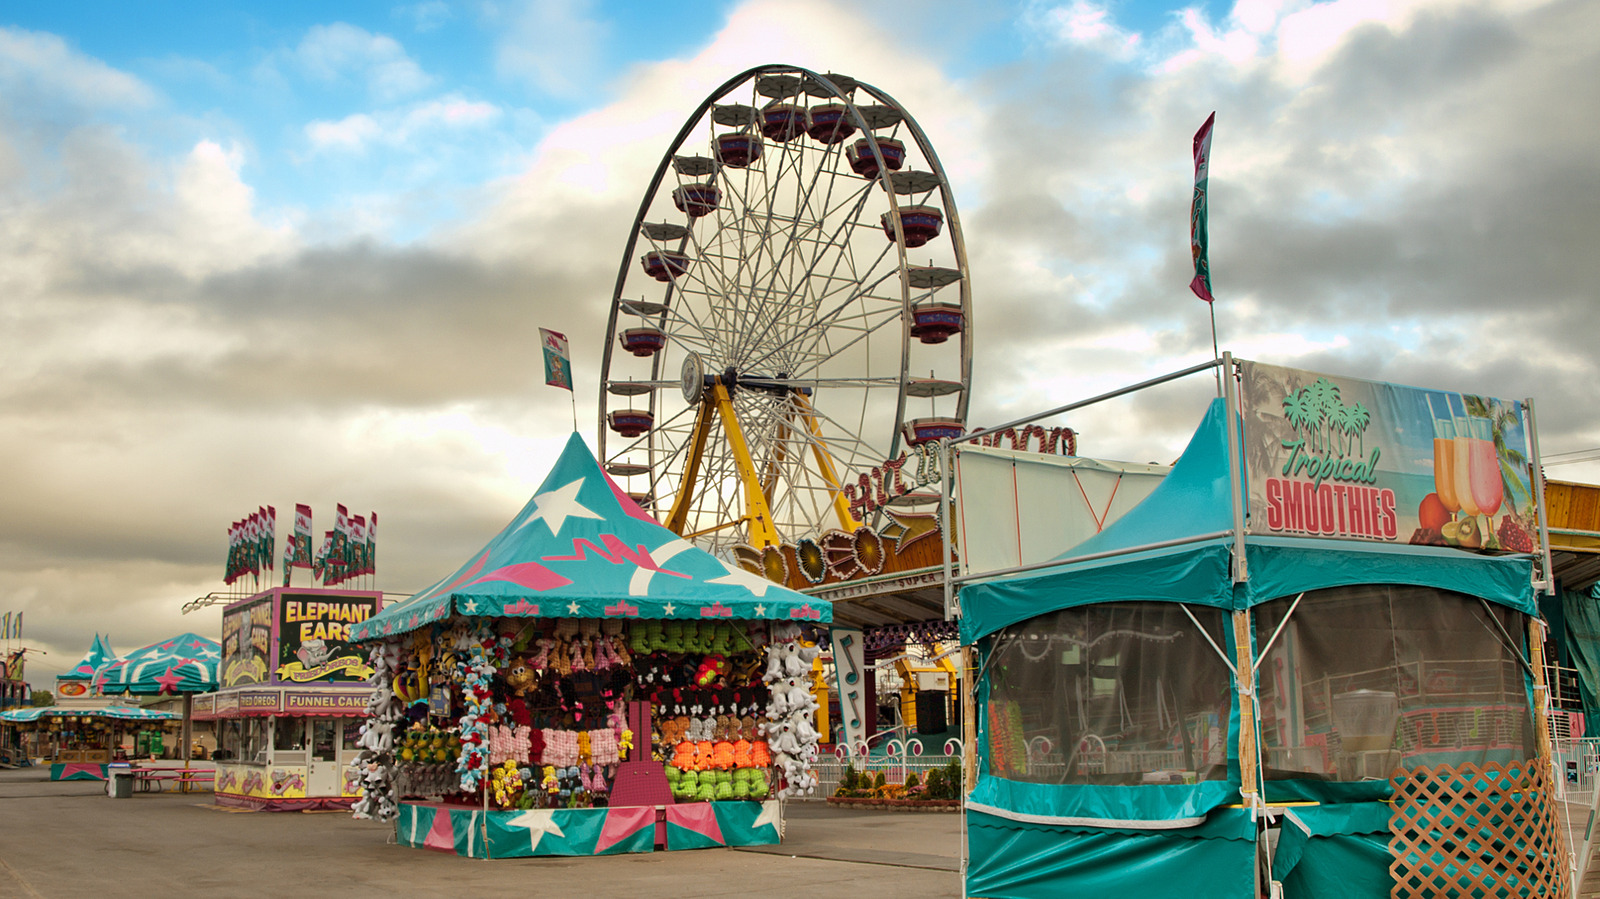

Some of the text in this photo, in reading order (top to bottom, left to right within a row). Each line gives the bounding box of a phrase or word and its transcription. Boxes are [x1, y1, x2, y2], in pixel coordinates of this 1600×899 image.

[1281, 439, 1381, 492] Tropical
[1265, 477, 1397, 541] SMOOTHIES
[899, 574, 936, 588] SUPER
[286, 601, 372, 623] ELEPHANT
[300, 622, 351, 642] EARS
[293, 658, 359, 680] FRIED OREOS
[254, 695, 276, 706] OREOS
[289, 696, 369, 707] FUNNEL CAKE
